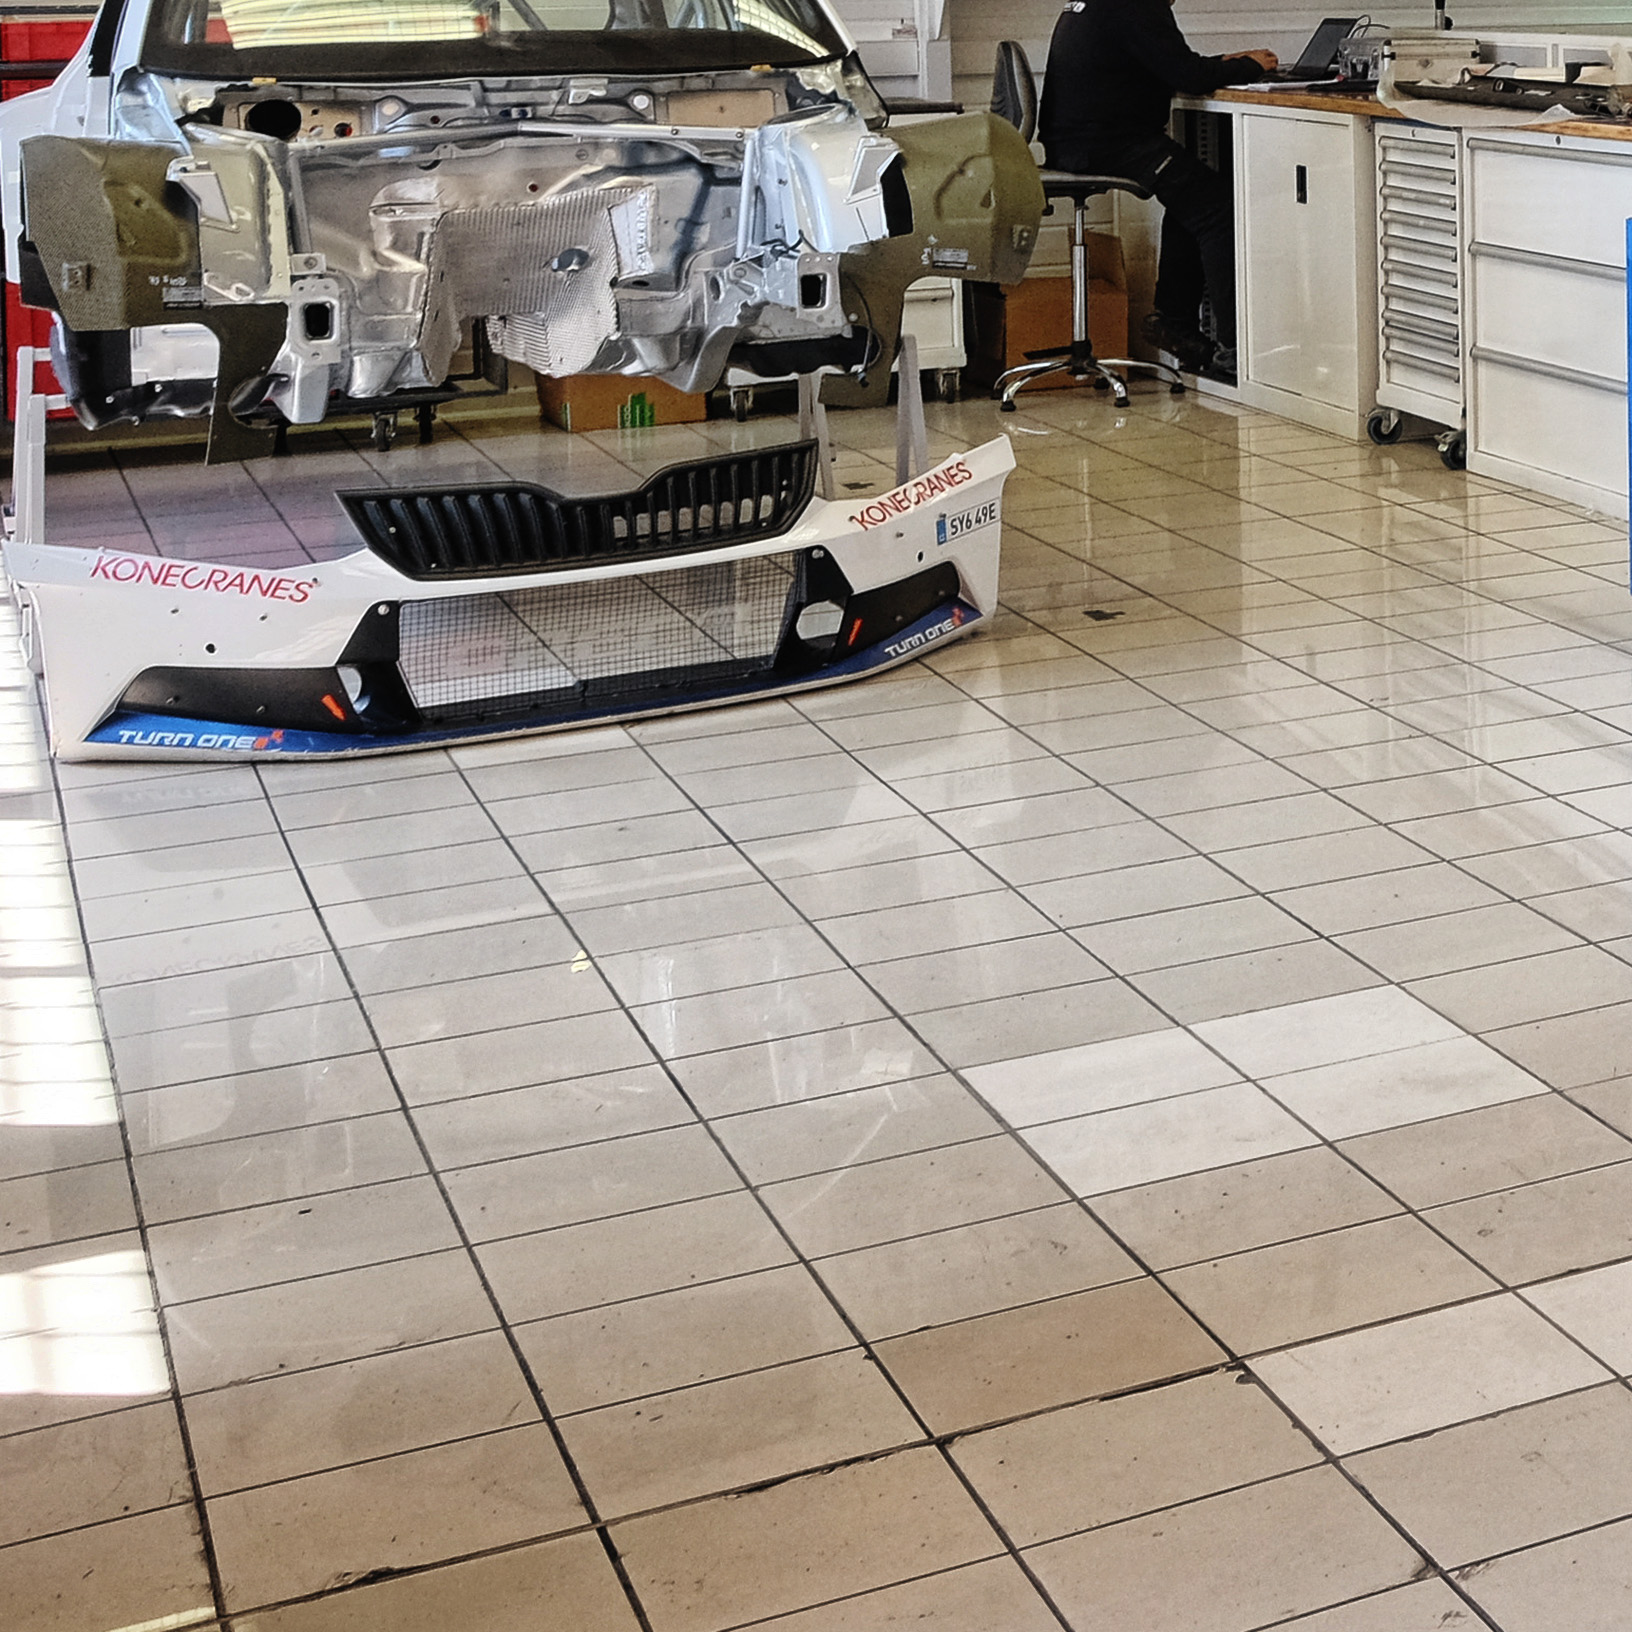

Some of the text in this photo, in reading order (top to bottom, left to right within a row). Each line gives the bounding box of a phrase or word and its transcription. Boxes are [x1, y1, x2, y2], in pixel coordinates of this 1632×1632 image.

[852, 461, 973, 531] KONECRANES
[91, 555, 315, 604] KONECRANES
[884, 618, 957, 658] TURN ONE
[118, 730, 257, 750] TURN ONE
